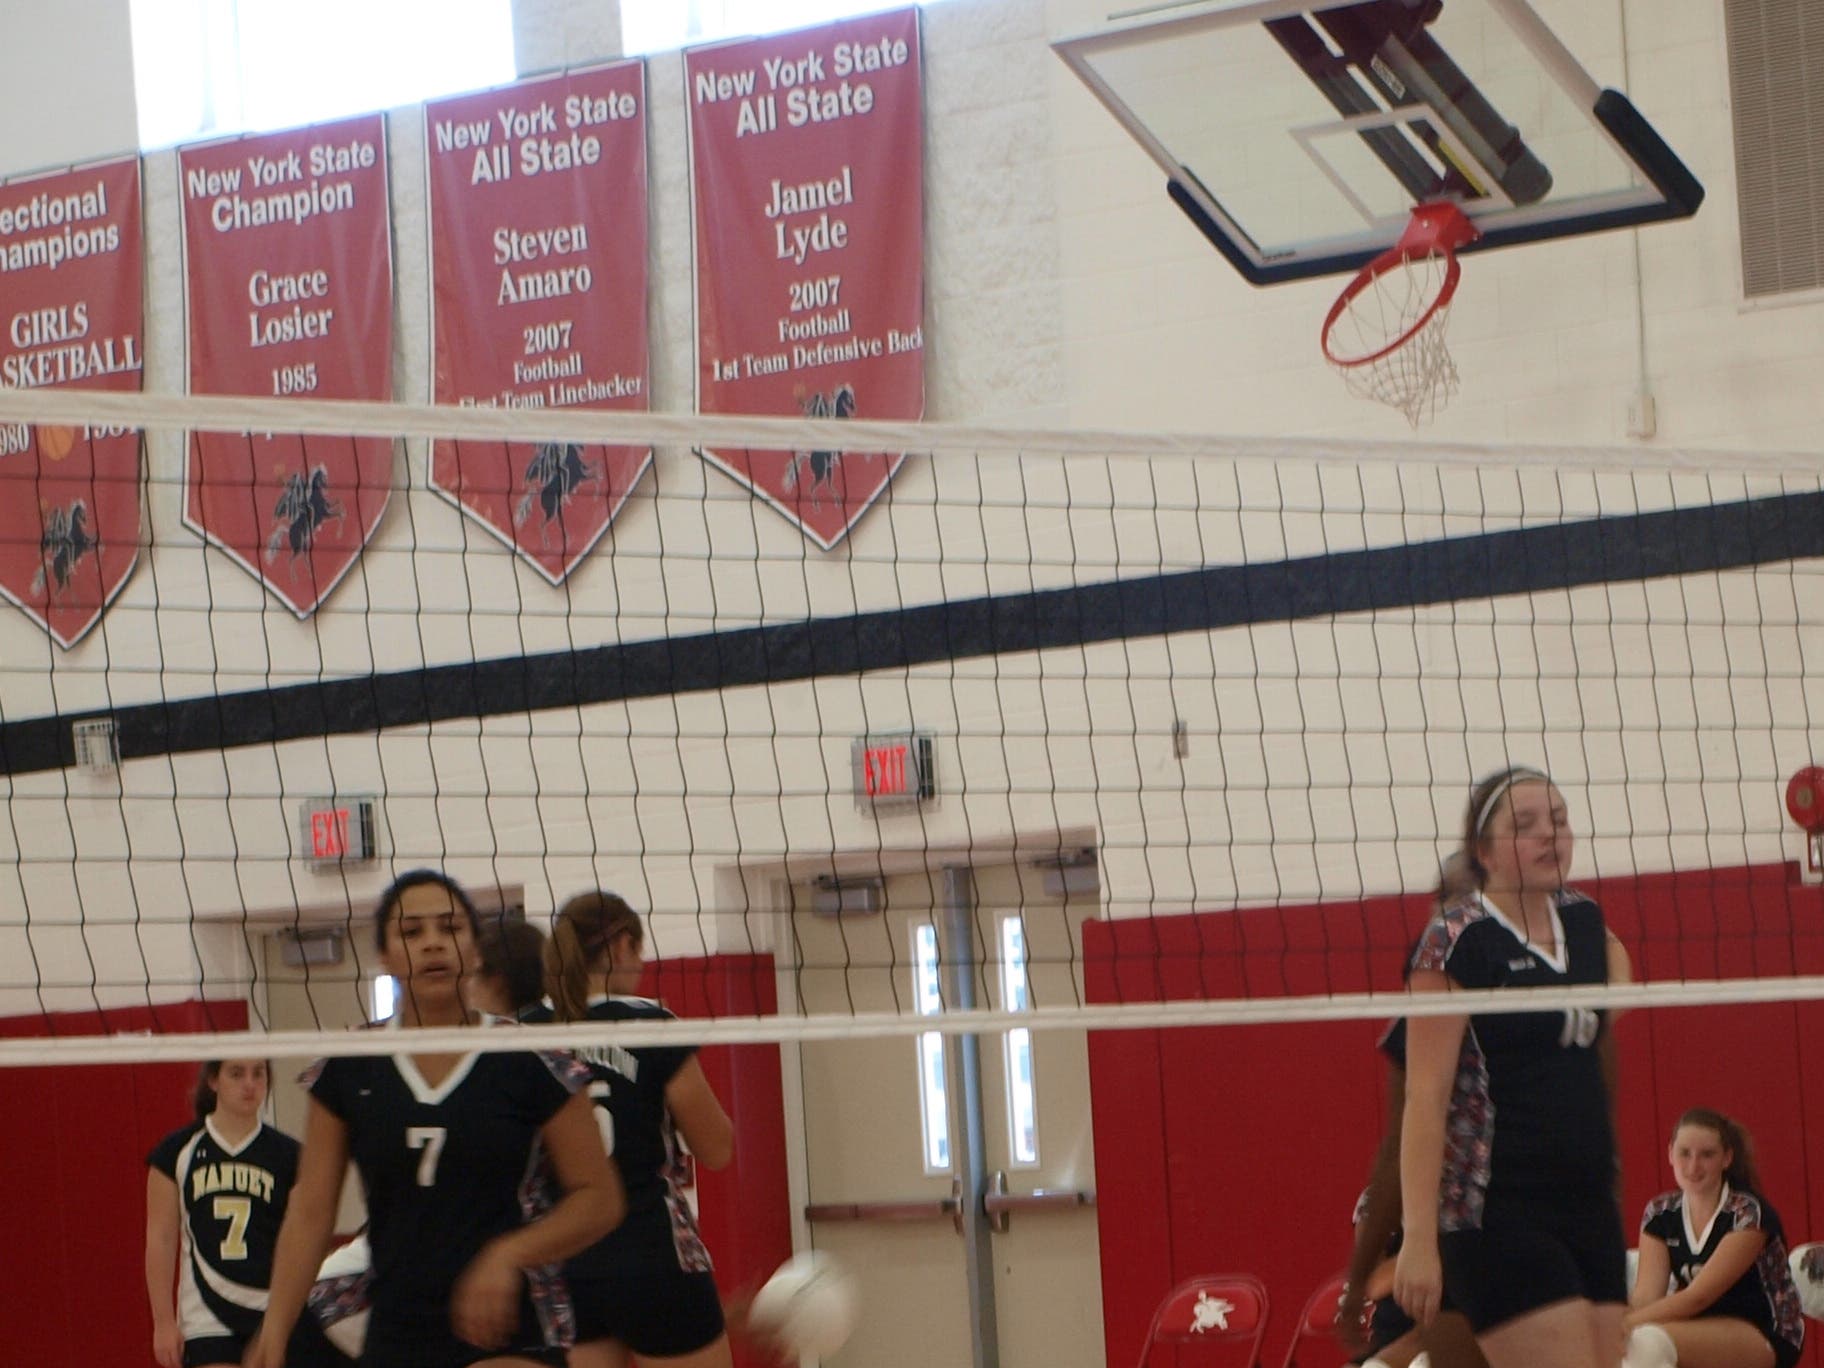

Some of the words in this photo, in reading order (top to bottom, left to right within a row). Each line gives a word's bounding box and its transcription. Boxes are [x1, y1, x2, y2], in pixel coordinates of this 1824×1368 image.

[696, 69, 755, 104] New
[763, 50, 826, 90] York
[833, 36, 909, 77] State
[435, 119, 491, 153] New
[498, 102, 557, 140] York
[565, 89, 637, 129] State
[736, 93, 777, 138] All
[787, 81, 874, 127] State
[188, 168, 241, 199] New
[249, 151, 303, 188] York
[310, 140, 376, 177] State
[471, 143, 511, 186] All
[520, 132, 600, 176] State
[212, 180, 354, 233] Champion
[765, 165, 854, 219] Jamel
[493, 223, 588, 265] Steven
[775, 213, 848, 265] Lyde
[249, 269, 329, 307] Grace
[497, 264, 592, 306] Amaro
[789, 275, 841, 313] 2007
[11, 300, 89, 349] GIRLS
[249, 304, 333, 348] Losier
[523, 319, 573, 355] 2007
[778, 308, 851, 343] Football
[0, 334, 143, 389] SKETBALL
[271, 361, 318, 396] 1985
[513, 351, 583, 385] Football
[712, 358, 740, 382] 1st
[743, 351, 790, 378] Team
[793, 335, 883, 370] Defensive
[502, 390, 546, 411] Team
[549, 373, 643, 407] Linebacker
[865, 744, 907, 797] EXIT
[311, 808, 349, 858] EXIT
[405, 1126, 448, 1187] 7
[192, 1161, 275, 1204] NANUET
[213, 1195, 252, 1260] 7
